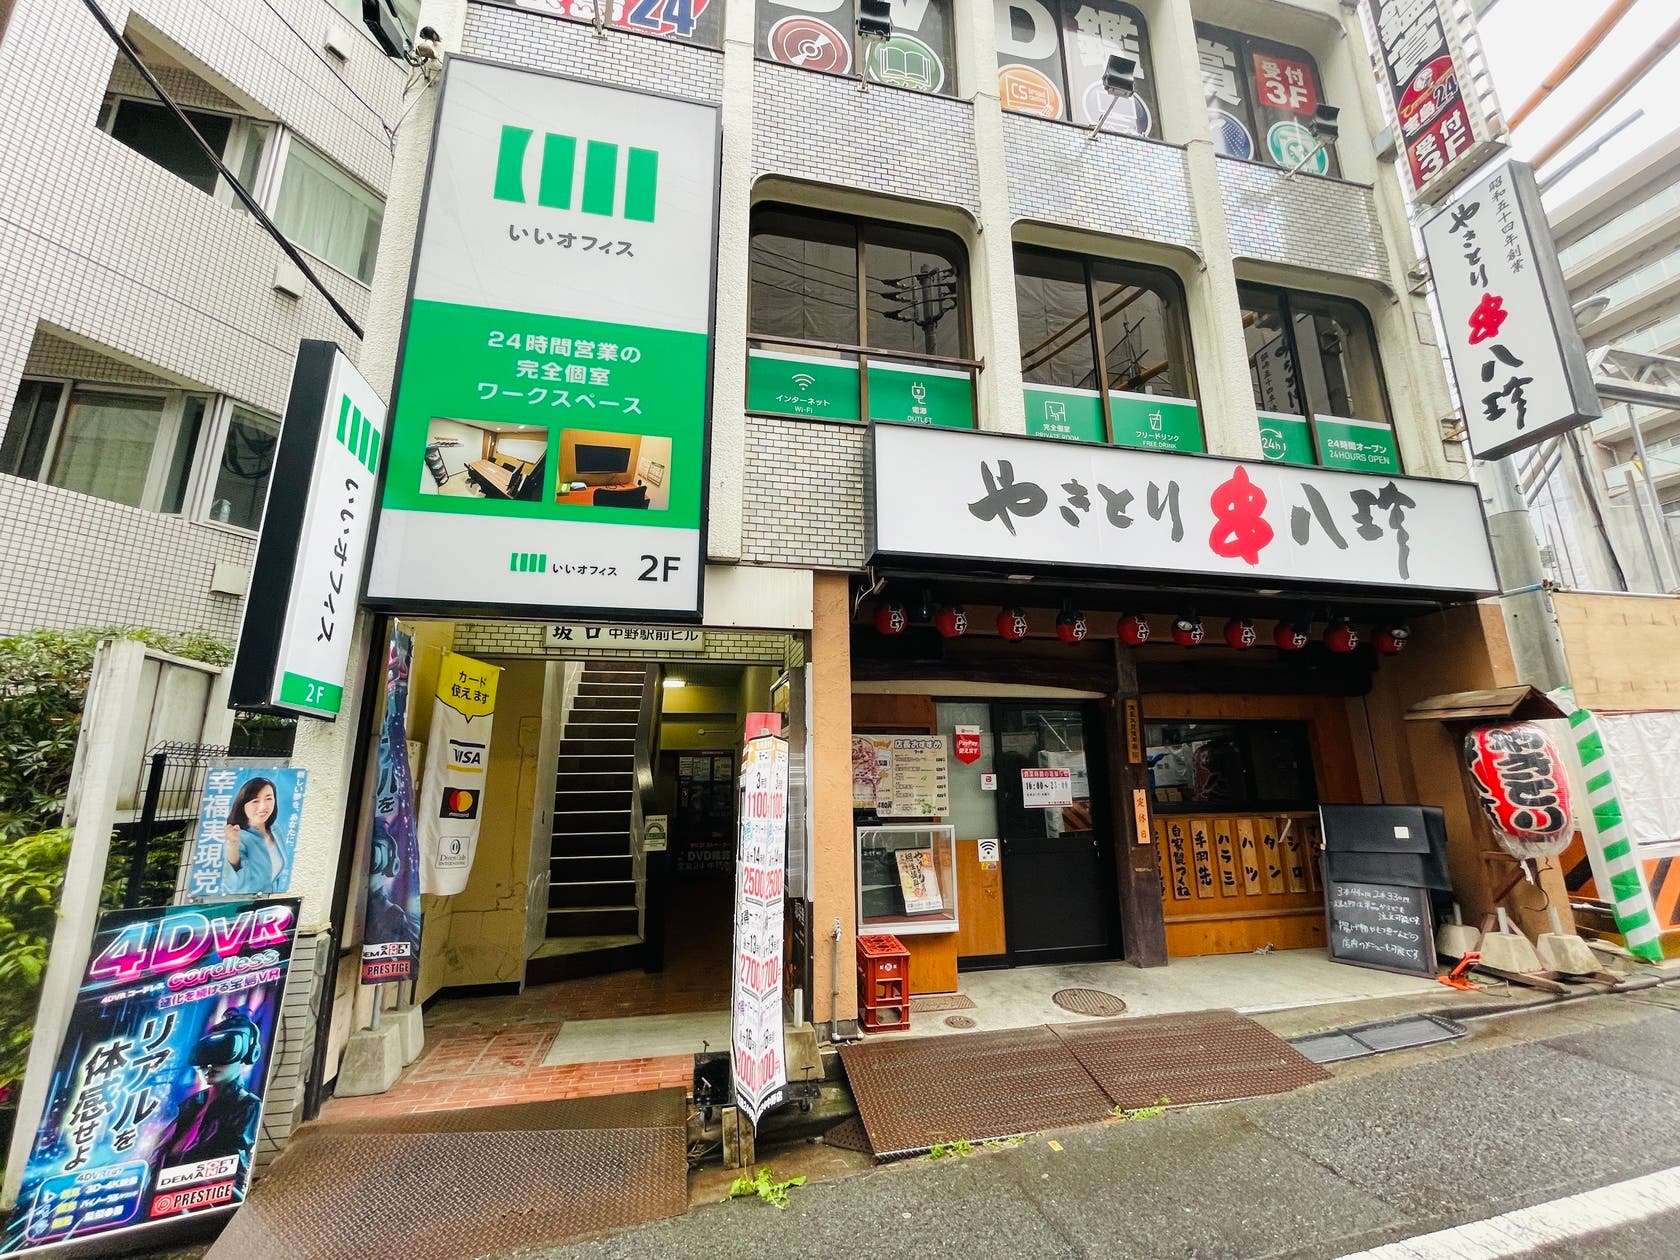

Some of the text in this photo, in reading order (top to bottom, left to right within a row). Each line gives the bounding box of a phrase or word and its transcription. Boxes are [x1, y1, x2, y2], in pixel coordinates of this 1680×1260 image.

[1262, 60, 1303, 86] 受付
[1011, 81, 1028, 101] CS
[1267, 80, 1307, 109] 3F
[1416, 109, 1462, 161] 受付
[1421, 126, 1466, 182] 3F
[1488, 175, 1525, 274] 昭和五十四年創業
[509, 224, 634, 258] いいオフィス
[488, 331, 641, 364] 24時間営業の
[516, 360, 610, 386] 完全個室
[477, 382, 642, 415] ワークスペース
[775, 395, 830, 406] インターネット
[794, 405, 813, 414] Wi-Fi
[907, 415, 932, 424] OUTLET
[1043, 423, 1071, 433] 完全個室
[1035, 431, 1060, 440] PRIVATE
[1135, 430, 1180, 442] フリードリンク
[1142, 440, 1178, 450] FREE DRINK
[1262, 437, 1281, 450] 24h
[1327, 438, 1388, 454] 24時間オープン
[1329, 450, 1391, 465] 24HOURS OPEN
[317, 477, 360, 644] いいオフィス
[552, 554, 682, 582] いいオフィス 2F
[607, 627, 700, 642] 中野駅前ビル
[458, 669, 488, 688] カード
[304, 682, 325, 705] 2F
[450, 683, 490, 706] 使えます
[454, 748, 482, 765] VISA
[958, 739, 979, 748] PayPay
[1135, 797, 1148, 839] 定休日
[190, 770, 237, 895] 幸福実現党
[1171, 824, 1192, 897] 自家製つくね
[1194, 830, 1213, 886] 手羽先
[1218, 834, 1235, 886] ハラミ
[1241, 837, 1259, 882] ハツ
[1264, 834, 1282, 879] タン
[1286, 835, 1303, 878] シロ
[743, 866, 765, 898] 2500
[90, 904, 295, 981] 4DVR
[363, 949, 405, 958] EMAND
[167, 948, 281, 992] cordless
[367, 962, 409, 976] PRESTIGE
[113, 1011, 178, 1153] リアルを
[65, 1040, 133, 1171] 体感せよ
[160, 1165, 229, 1187] DEMAND
[195, 1156, 238, 1172] SOFT
[173, 1183, 233, 1209] PRESTIGE
